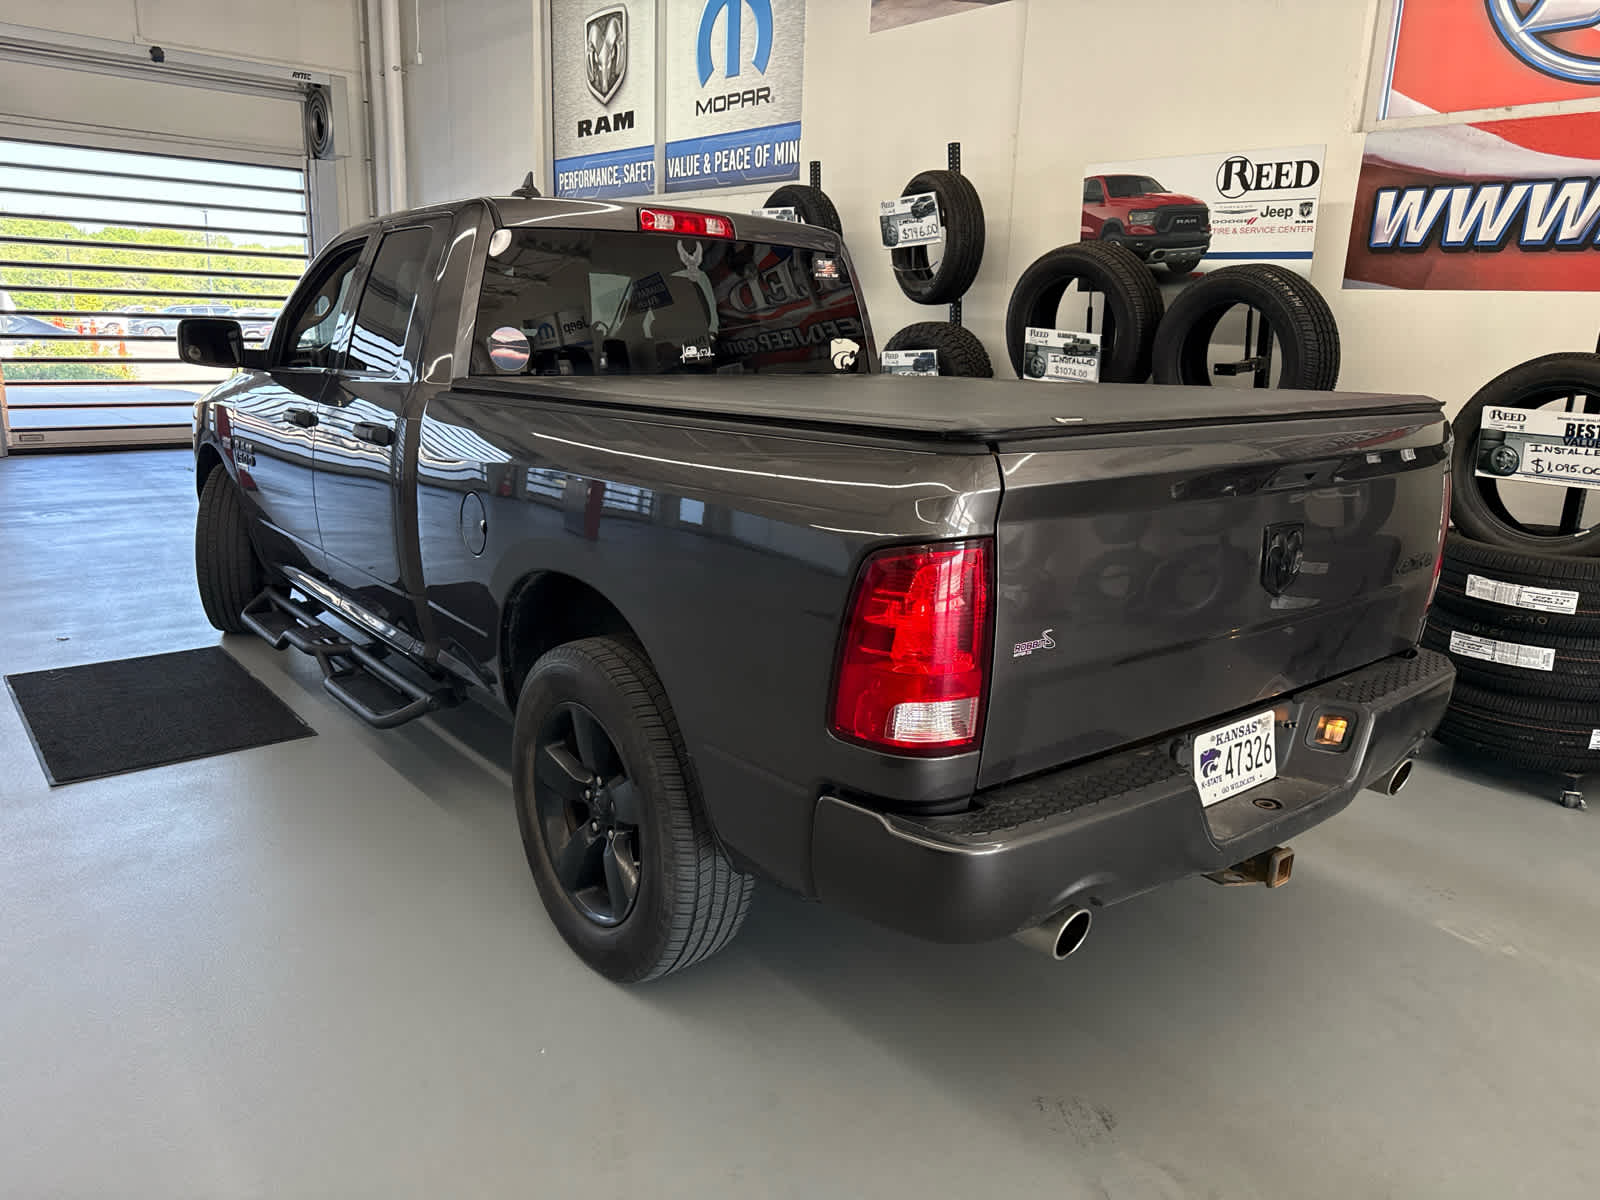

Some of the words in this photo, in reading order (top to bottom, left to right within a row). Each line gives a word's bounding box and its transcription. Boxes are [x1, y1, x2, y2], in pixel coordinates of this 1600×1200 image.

[695, 87, 771, 117] MOPAR
[577, 110, 635, 138] RAM
[667, 154, 700, 179] VALUE
[703, 153, 712, 175] &
[714, 147, 751, 173] PEACE
[754, 144, 771, 168] OF
[774, 138, 801, 166] MIN
[559, 165, 622, 191] PERFORMANCE,
[1219, 159, 1320, 191] REED
[1260, 205, 1293, 220] Jeep
[1212, 227, 1231, 235] TIRE
[1239, 226, 1278, 235] SERVICE
[1279, 225, 1314, 233] CENTER
[1055, 366, 1088, 378] $1074.00
[1491, 409, 1527, 422] REED
[1215, 721, 1258, 746] KANSAS
[1225, 733, 1272, 779] 47326
[1201, 775, 1222, 790] K-STATE
[1221, 785, 1230, 794] GO
[1230, 776, 1256, 791] WILDCATS
